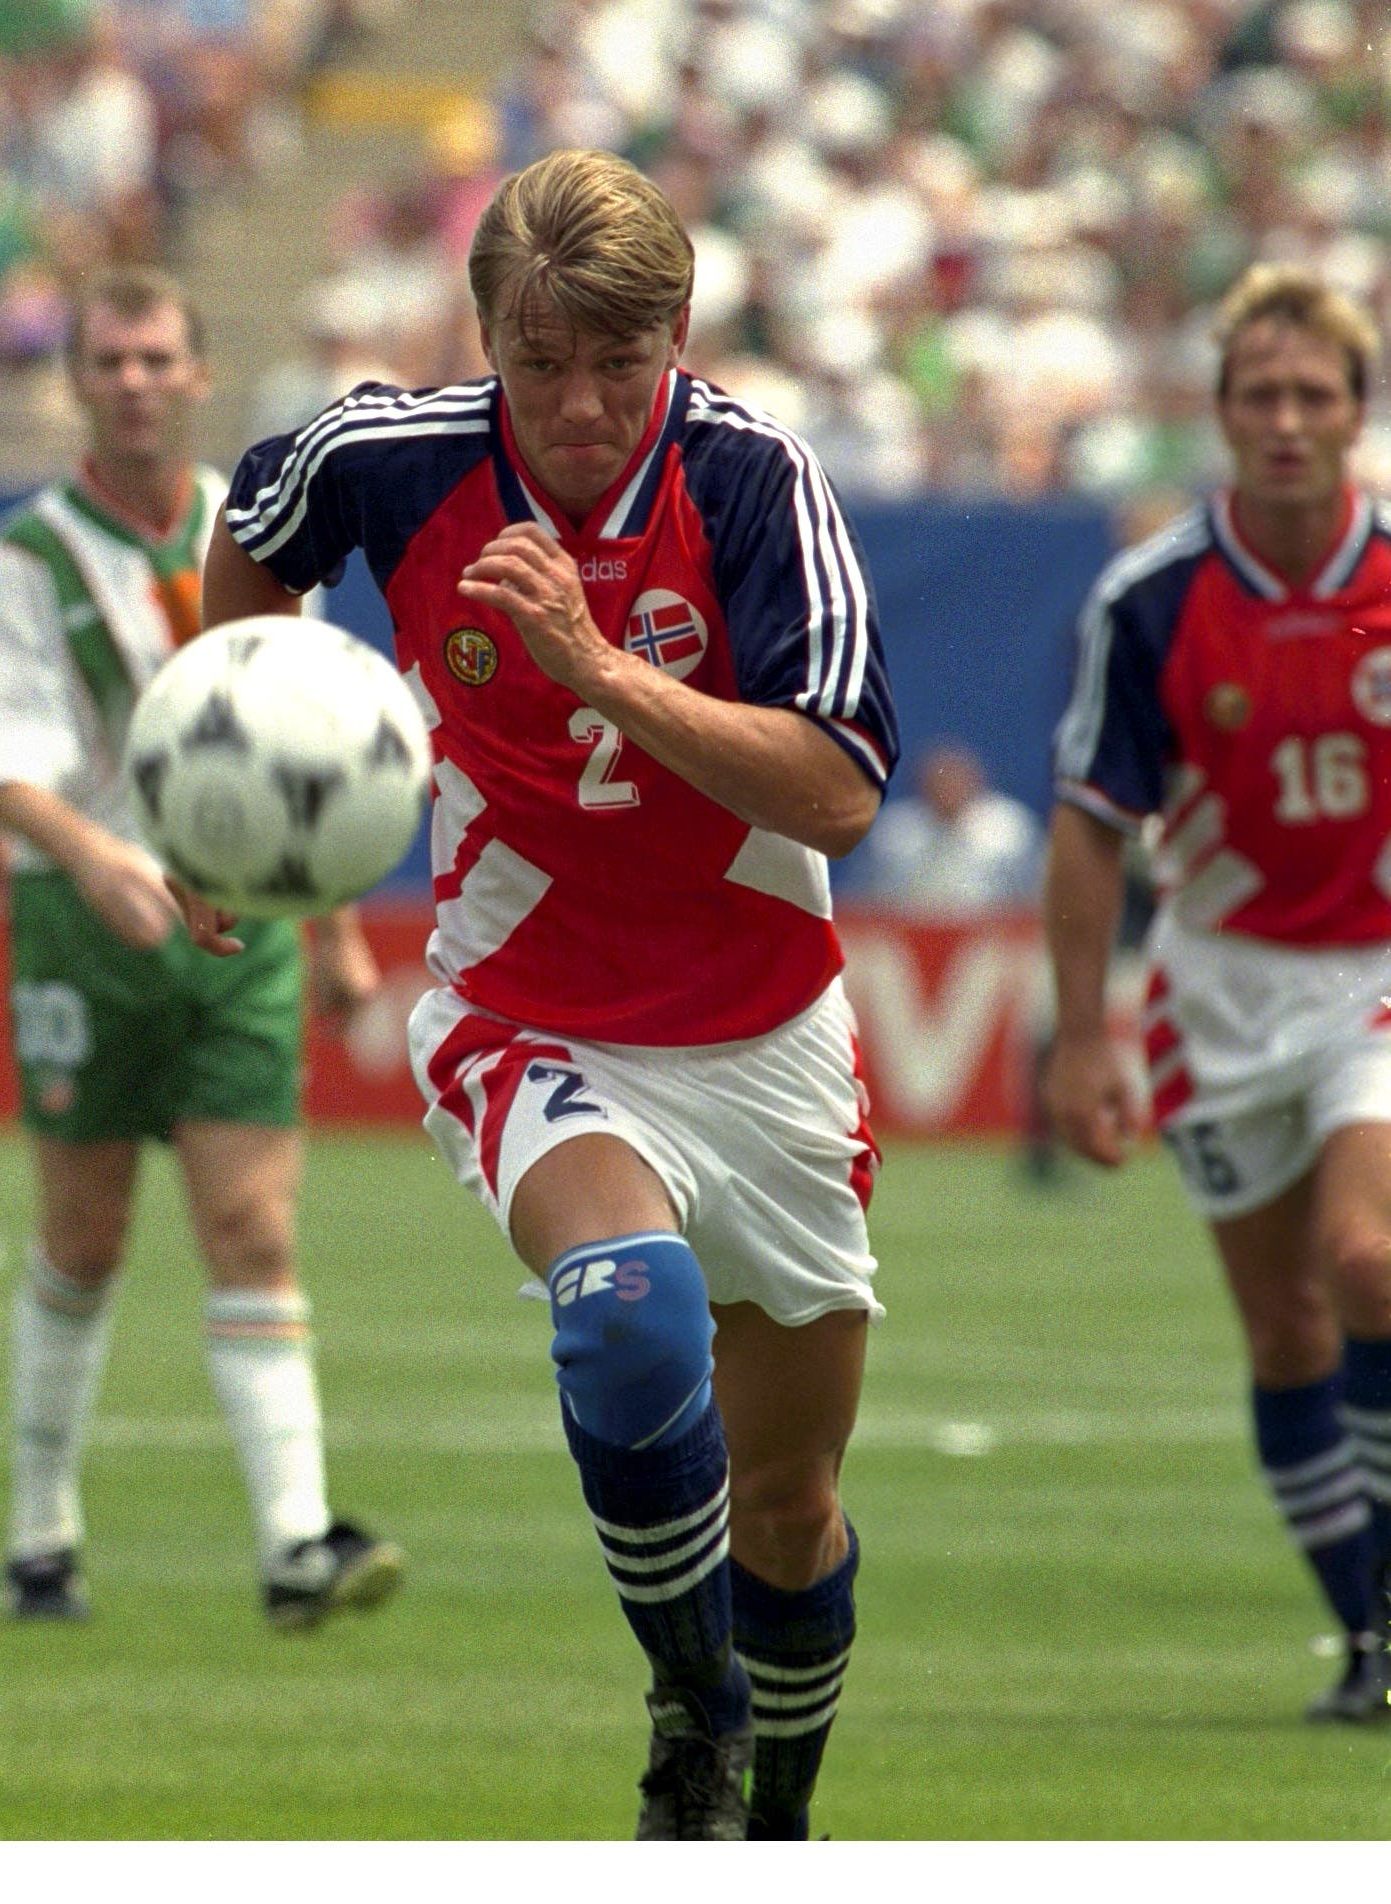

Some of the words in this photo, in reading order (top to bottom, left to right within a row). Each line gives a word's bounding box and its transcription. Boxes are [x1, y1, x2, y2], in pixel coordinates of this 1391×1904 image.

[581, 556, 627, 582] das
[568, 706, 641, 811] 2
[1269, 732, 1372, 828] 16
[527, 1063, 608, 1123] 2
